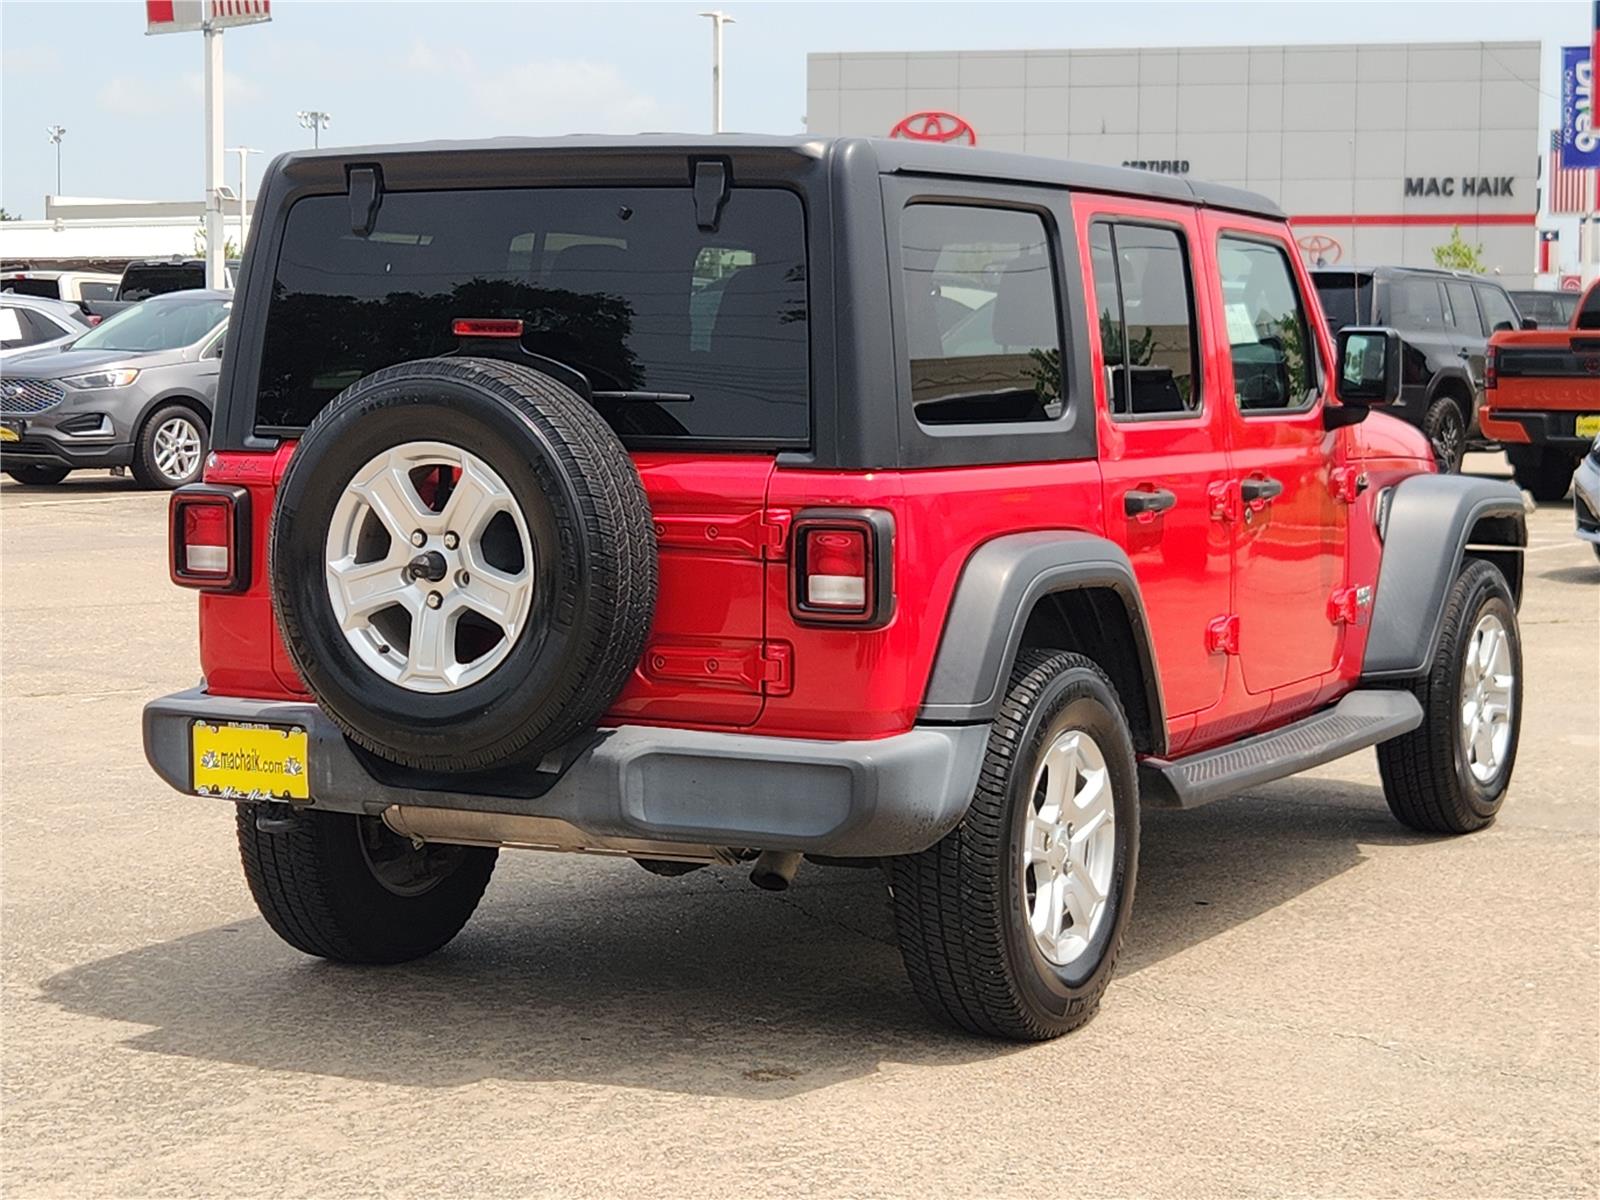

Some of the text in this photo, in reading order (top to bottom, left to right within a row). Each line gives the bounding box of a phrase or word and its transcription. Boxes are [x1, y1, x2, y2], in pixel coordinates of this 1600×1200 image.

[1404, 176, 1515, 198] MAC HAIK
[220, 747, 284, 774] machaik.com
